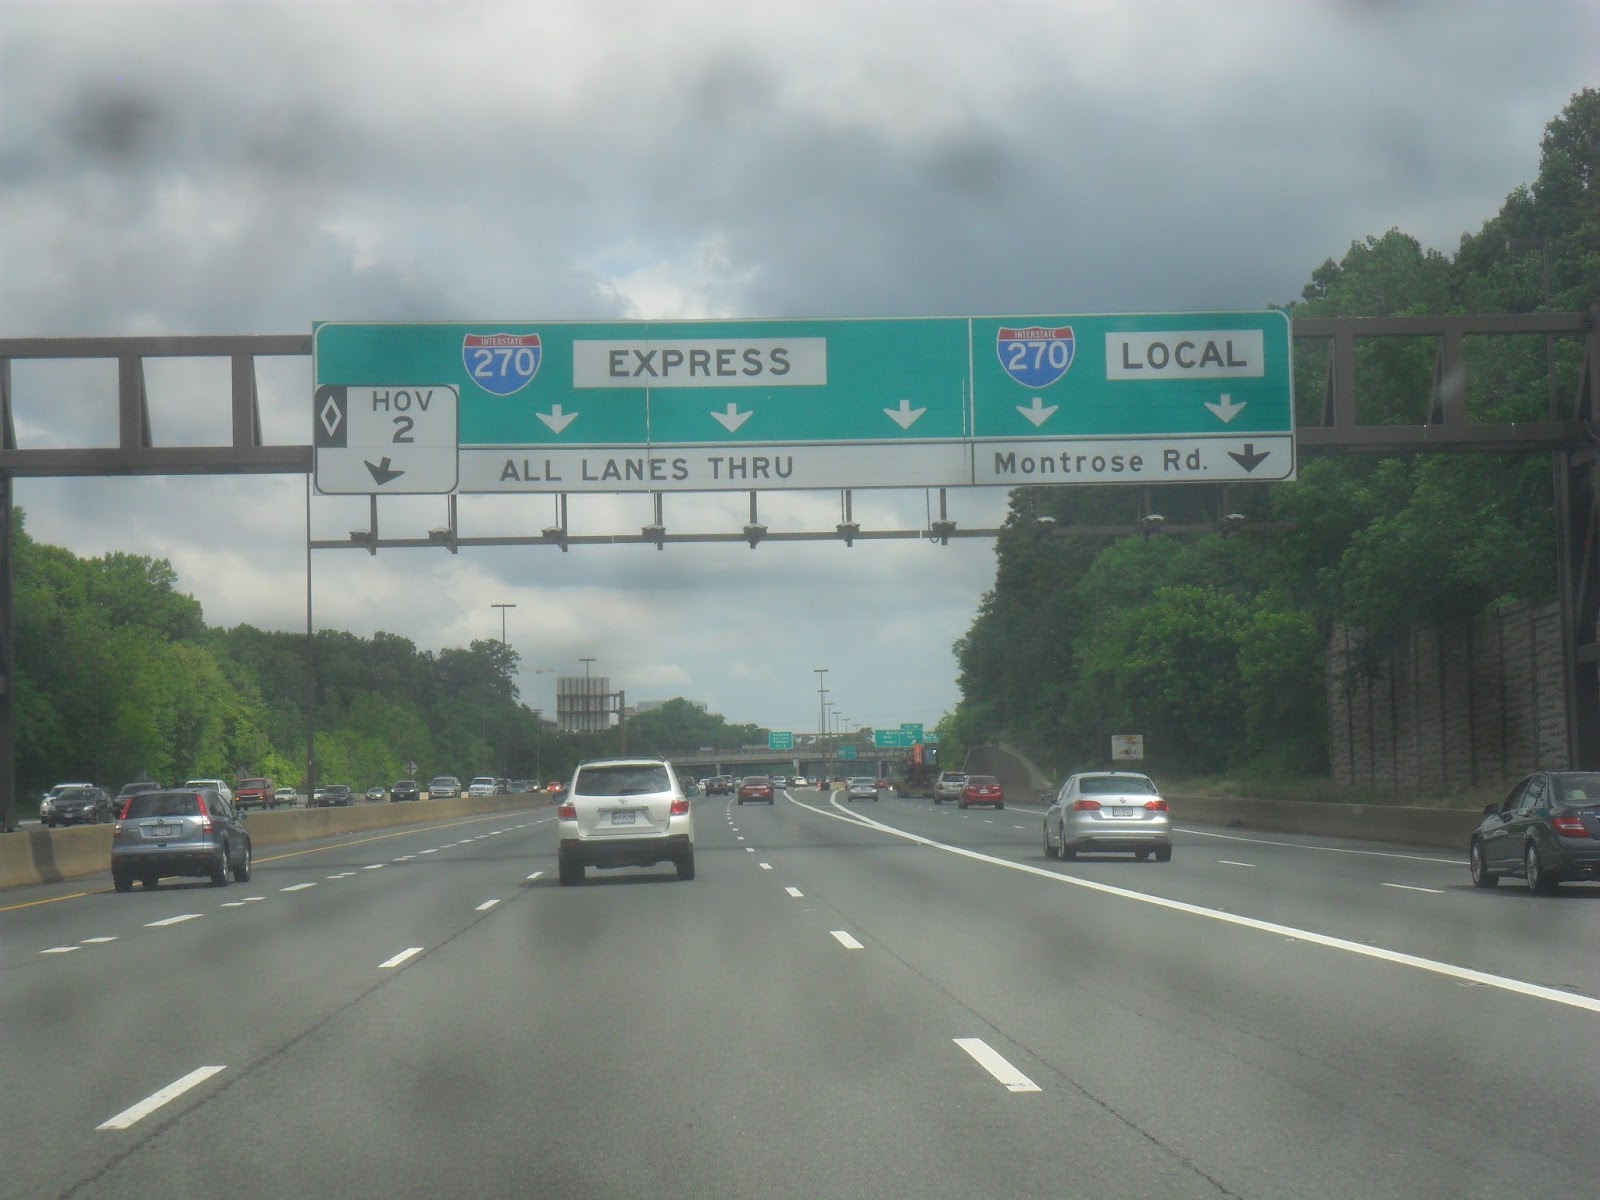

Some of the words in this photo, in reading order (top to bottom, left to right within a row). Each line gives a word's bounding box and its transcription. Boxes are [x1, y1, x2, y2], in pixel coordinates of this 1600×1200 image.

[481, 336, 524, 346] INTERSTATE
[1014, 330, 1057, 339] INTERSTATE
[474, 349, 535, 377] 270
[609, 348, 791, 377] EXPRESS
[1008, 341, 1068, 370] 270
[1122, 340, 1247, 370] LOCAL
[372, 390, 433, 412] HOV
[392, 416, 414, 443] 2
[500, 459, 561, 481] ALL
[581, 458, 689, 481] LANES
[708, 456, 793, 479] THRU
[995, 452, 1144, 475] Montrose
[1163, 449, 1208, 471] Rd.
